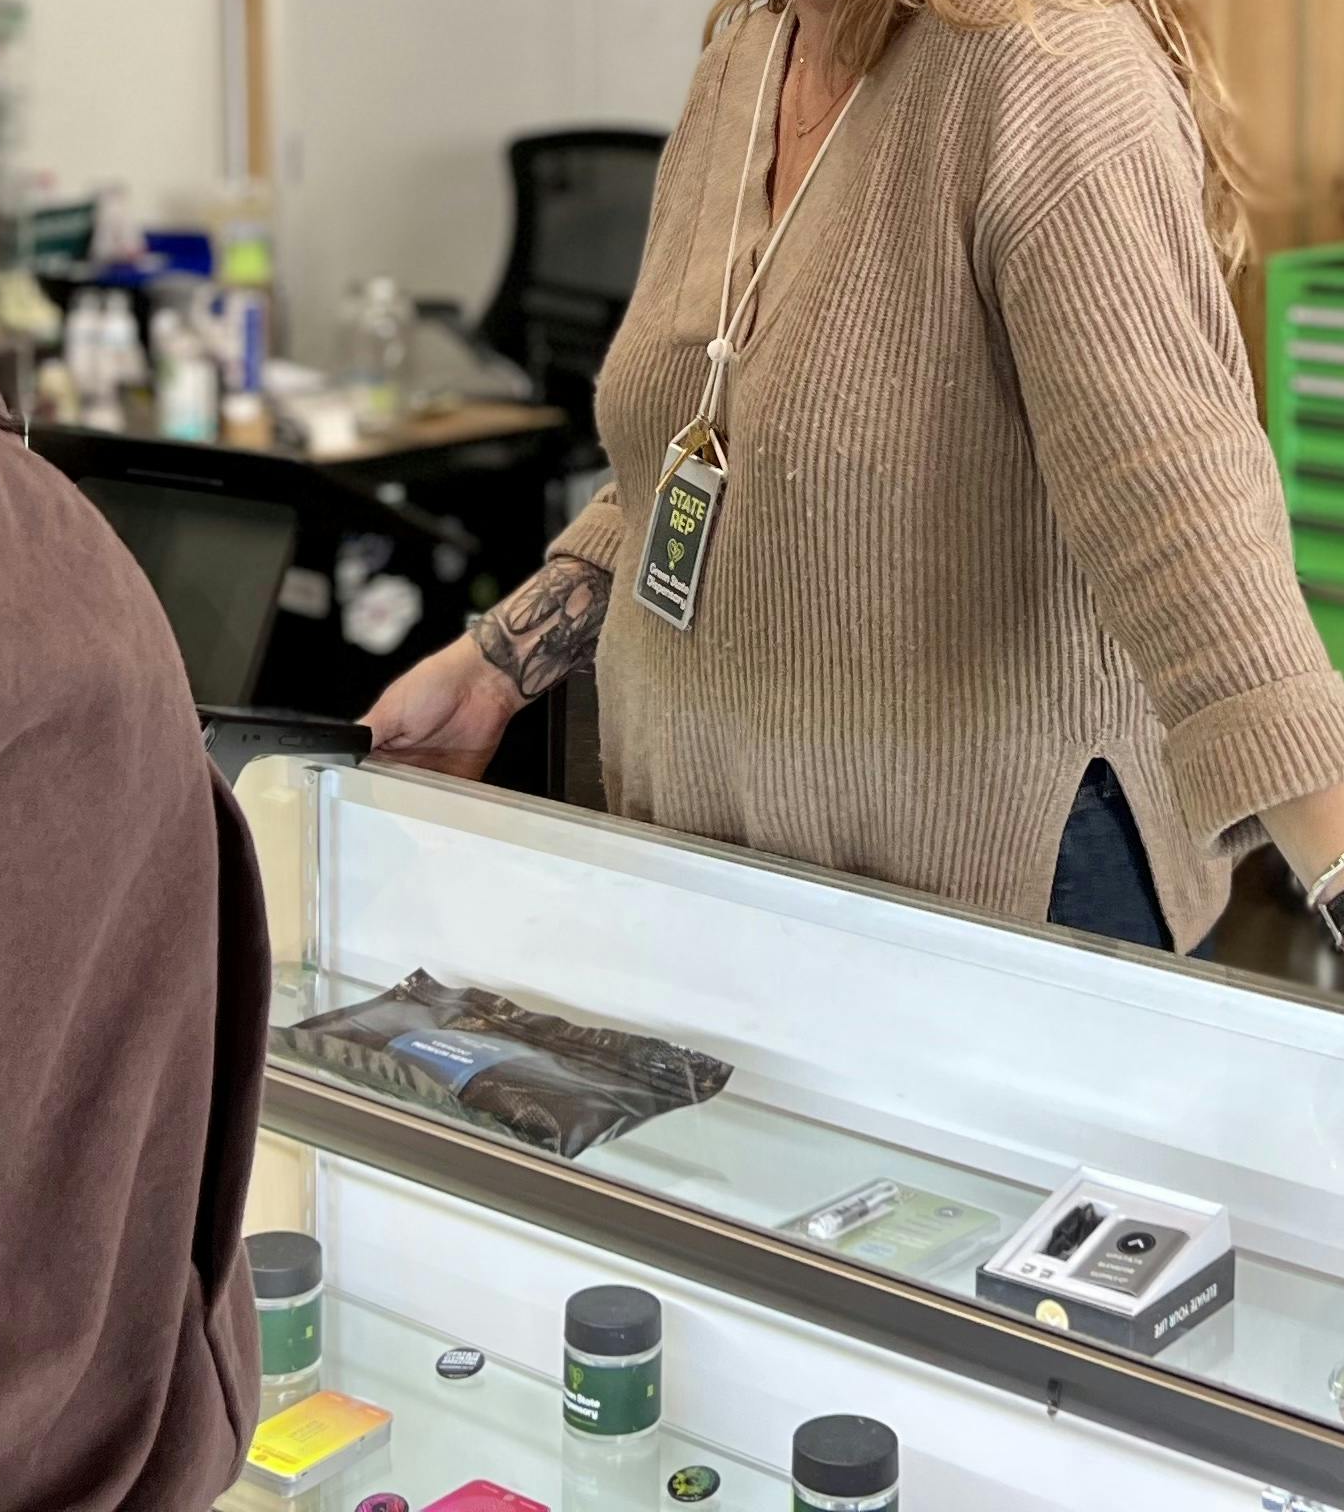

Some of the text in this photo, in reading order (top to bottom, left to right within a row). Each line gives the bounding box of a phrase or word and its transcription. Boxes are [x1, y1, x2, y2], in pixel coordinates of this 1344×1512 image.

[669, 486, 706, 521] STATE
[669, 508, 696, 536] REP
[649, 562, 670, 584] Green
[1153, 1282, 1218, 1339] ELEVATE YOUR LIFE
[576, 1392, 601, 1409] State
